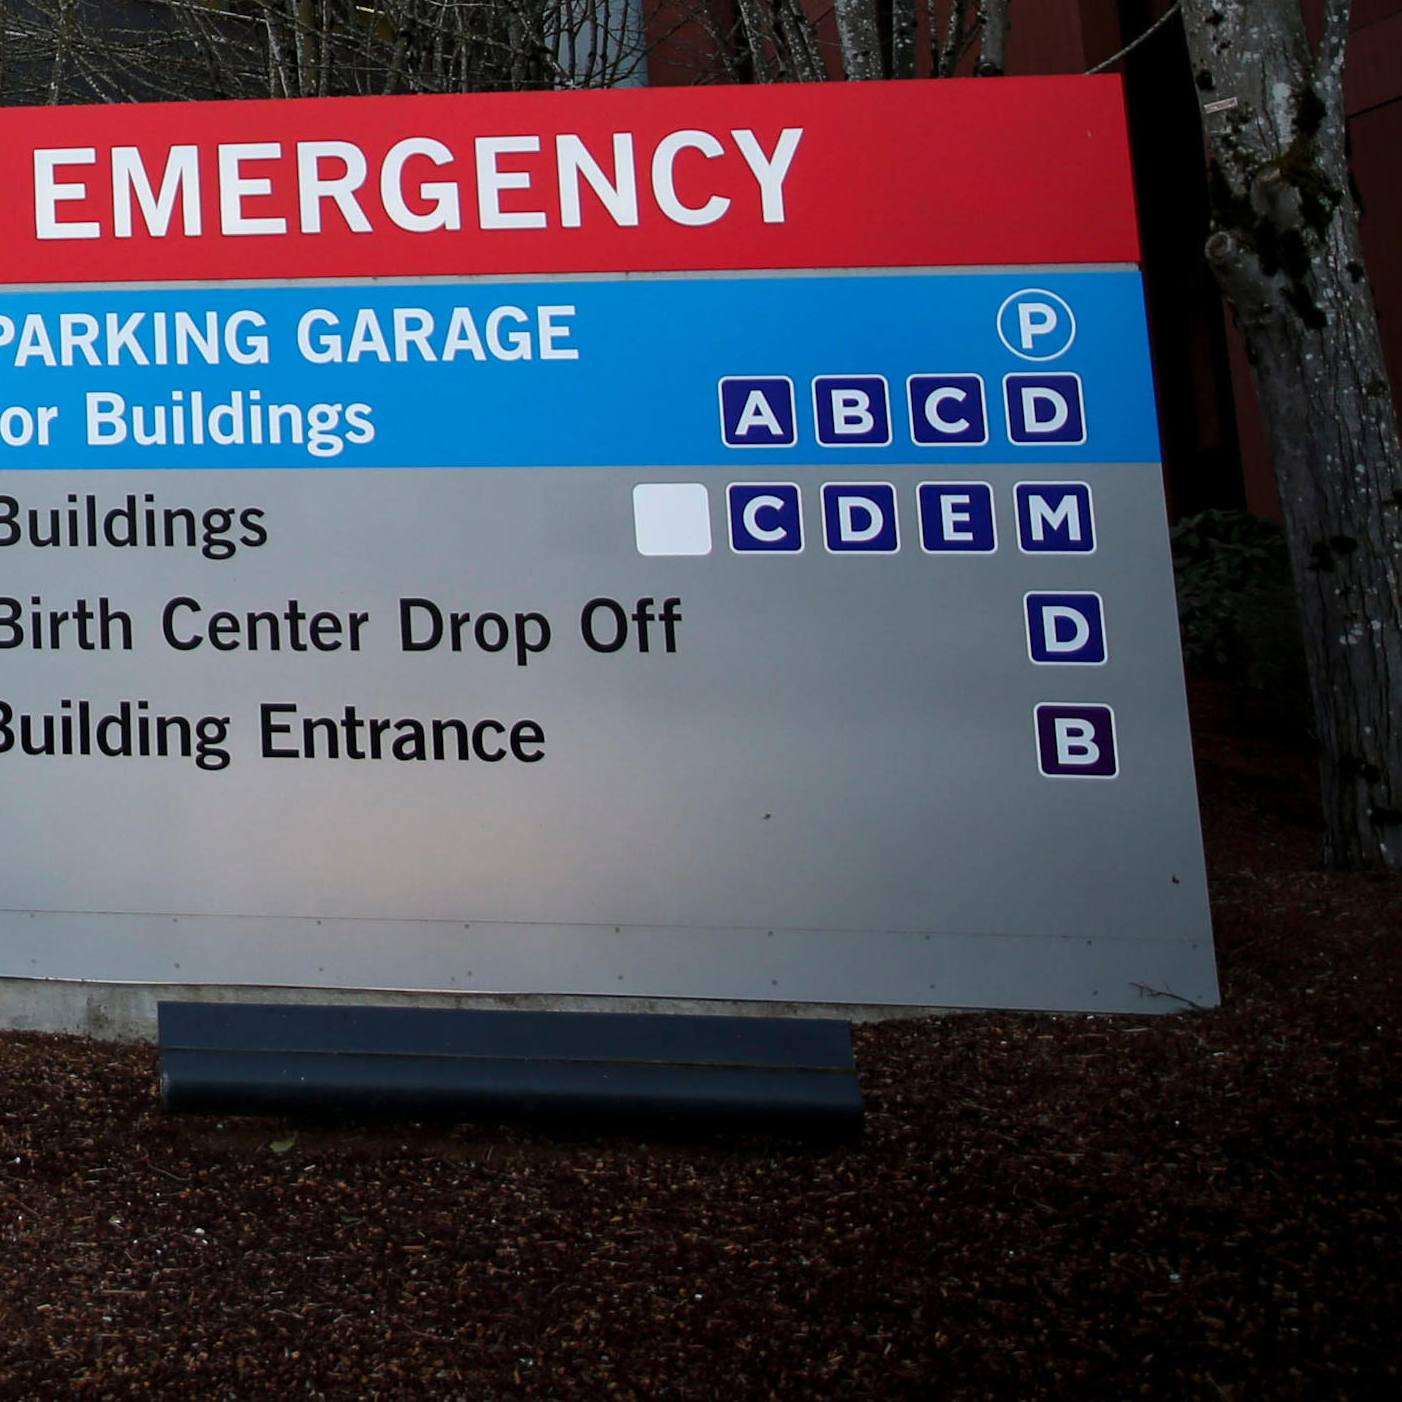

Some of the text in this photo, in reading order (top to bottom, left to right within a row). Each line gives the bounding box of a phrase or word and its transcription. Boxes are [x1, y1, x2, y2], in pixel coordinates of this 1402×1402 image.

[32, 127, 804, 241] EMERGENCY
[296, 304, 580, 365] GARAGE
[1017, 302, 1058, 350] P
[85, 389, 376, 458] Buildings
[734, 386, 1069, 436] A B C D
[742, 494, 1082, 543] C D E M
[161, 596, 370, 653] Center
[398, 598, 552, 667] Drop
[580, 597, 684, 655] Off
[1042, 605, 1090, 652] D
[259, 702, 547, 764] Entrance
[1054, 717, 1100, 765] B
